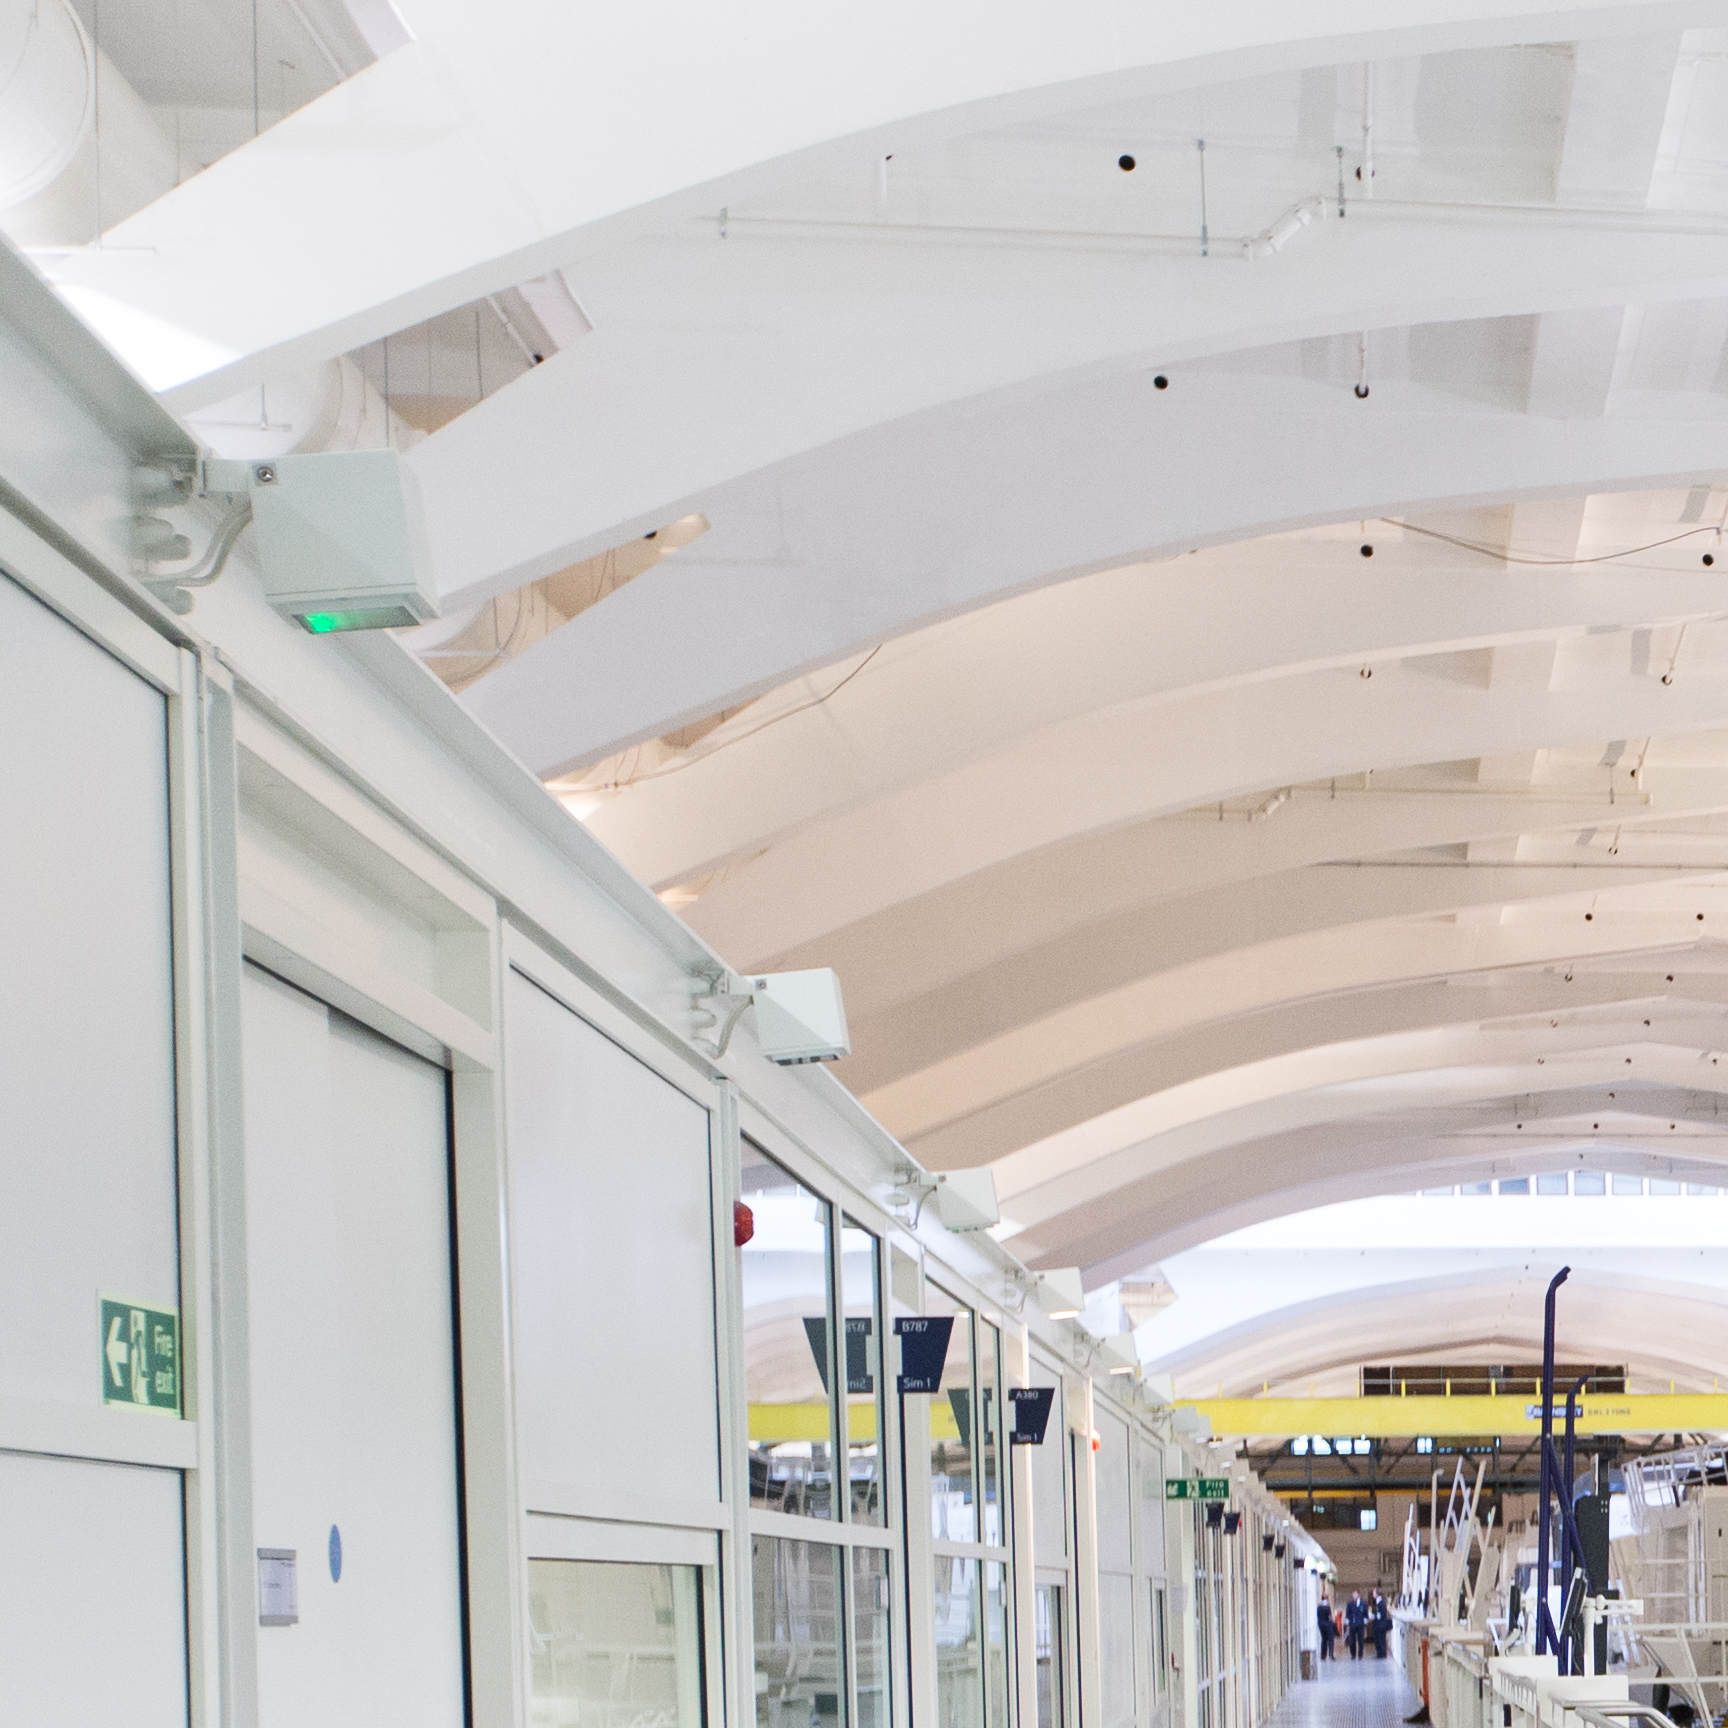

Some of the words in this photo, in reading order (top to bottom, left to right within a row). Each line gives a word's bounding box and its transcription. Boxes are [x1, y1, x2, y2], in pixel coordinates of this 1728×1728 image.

[901, 1320, 929, 1332] B787
[153, 1324, 174, 1358] Fire
[153, 1363, 175, 1395] exit
[903, 1377, 924, 1389] Sim
[1015, 1391, 1039, 1400] A380
